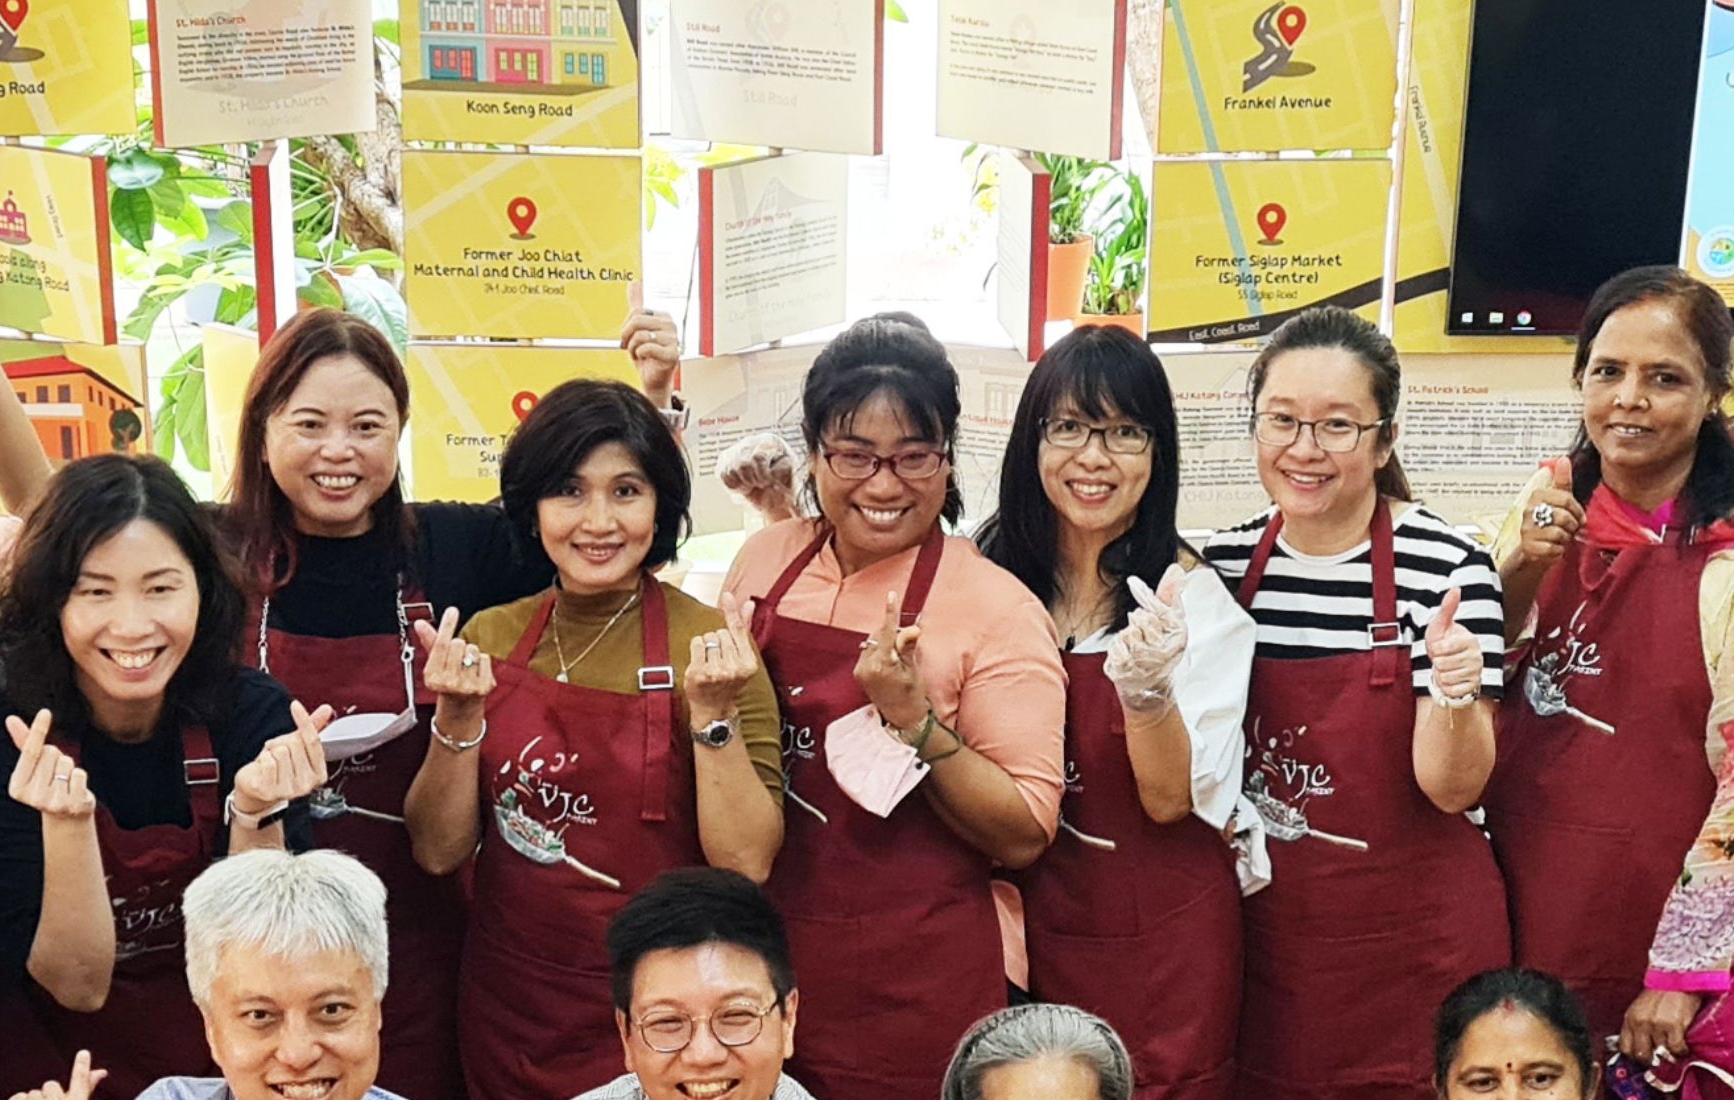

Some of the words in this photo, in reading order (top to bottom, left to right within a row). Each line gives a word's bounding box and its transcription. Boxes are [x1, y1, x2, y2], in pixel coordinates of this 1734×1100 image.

[217, 16, 246, 26] Church
[9, 81, 45, 94] Road
[467, 100, 499, 114] Koon
[503, 102, 535, 118] Seng
[538, 102, 573, 117] Road
[1224, 97, 1276, 111] Frankel
[1279, 96, 1331, 108] Avenue
[463, 247, 513, 261] Former
[517, 249, 540, 262] Joo
[544, 249, 583, 263] Chiat
[1195, 255, 1246, 268] Former
[1249, 255, 1288, 269] Siglap
[1291, 254, 1343, 267] Market
[413, 263, 479, 277] Maternal
[484, 265, 509, 278] and
[512, 265, 544, 279] Child
[547, 267, 595, 281] Health
[599, 268, 633, 281] Clinic
[1218, 272, 1262, 285] (Siglap
[1265, 271, 1319, 284] Centre)
[446, 433, 496, 446] Former
[1281, 760, 1331, 799] VJC
[537, 786, 594, 822] VJC
